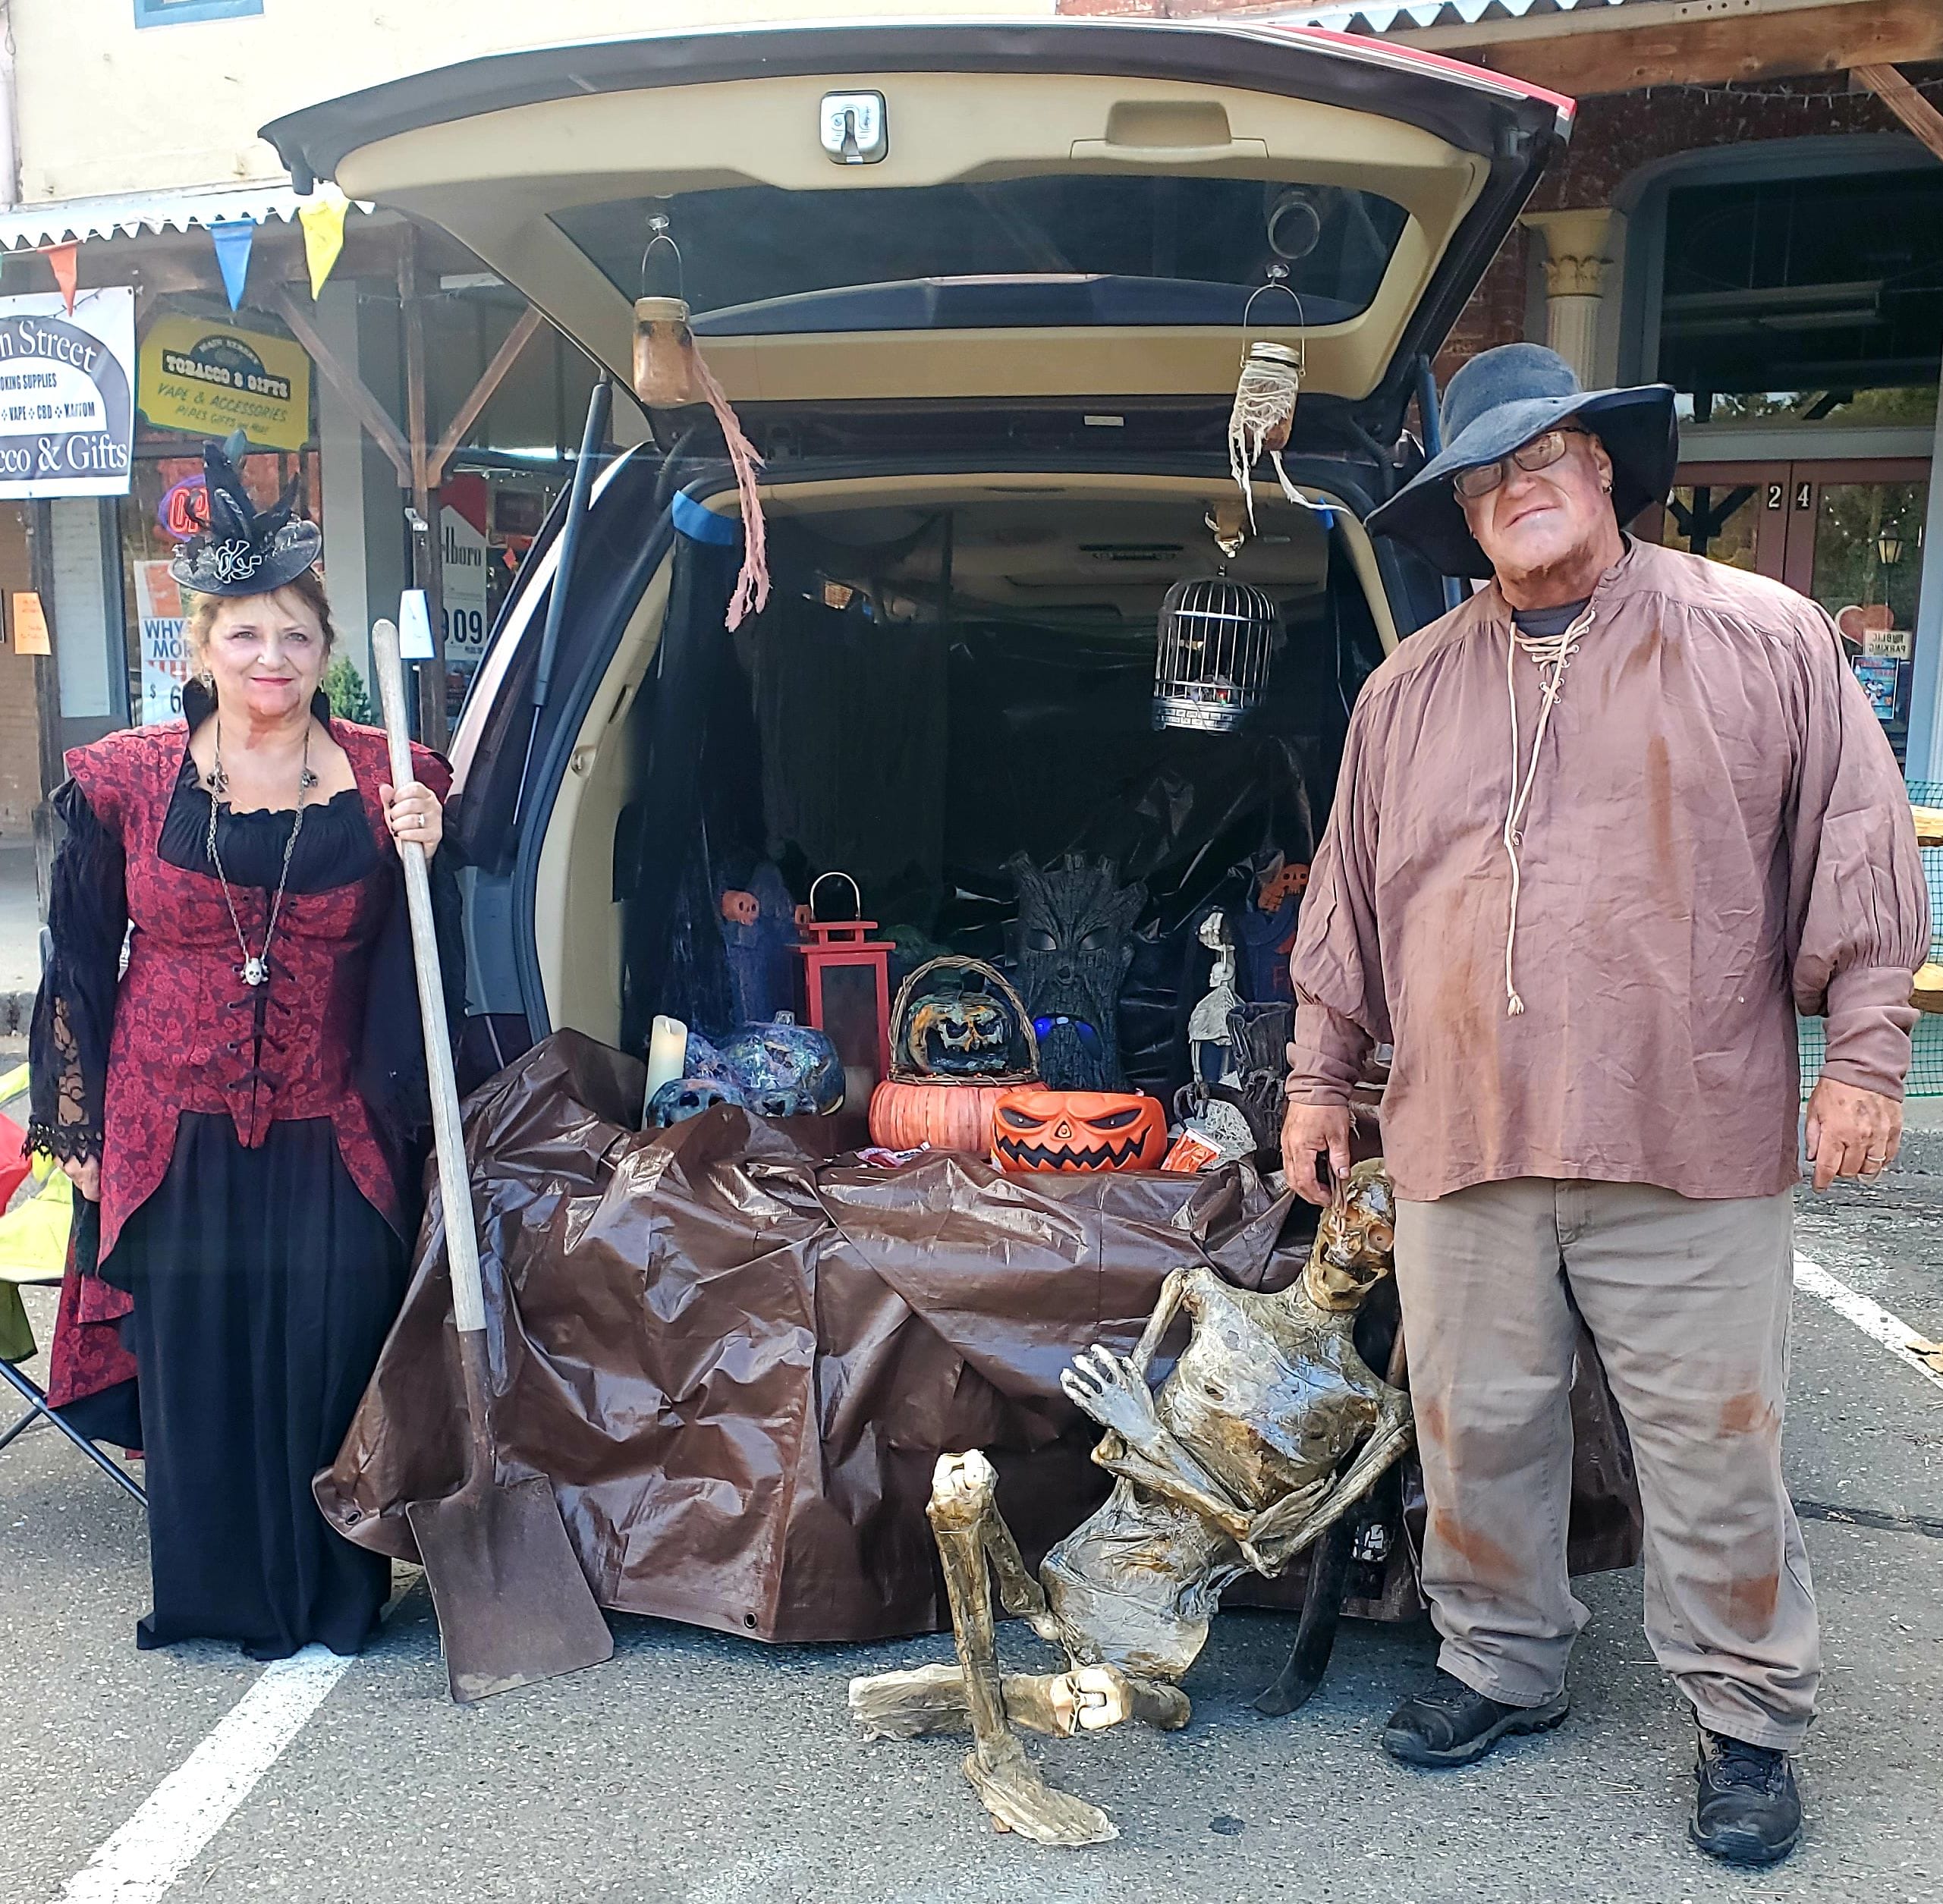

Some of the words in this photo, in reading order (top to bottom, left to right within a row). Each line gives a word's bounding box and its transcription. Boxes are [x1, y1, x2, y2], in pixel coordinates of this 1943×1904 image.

[19, 320, 97, 372] Street
[23, 372, 57, 389] SUPPLIES
[166, 355, 230, 384] TOBACCO
[8, 406, 27, 421] VAPE
[37, 404, 52, 419] CBD
[158, 382, 188, 401] VAPE
[193, 391, 204, 404] &
[209, 395, 287, 422] ACCESSORIES
[38, 437, 62, 471] &
[66, 434, 127, 470] Gifts
[445, 526, 482, 567] lboro
[144, 620, 184, 639] WHY
